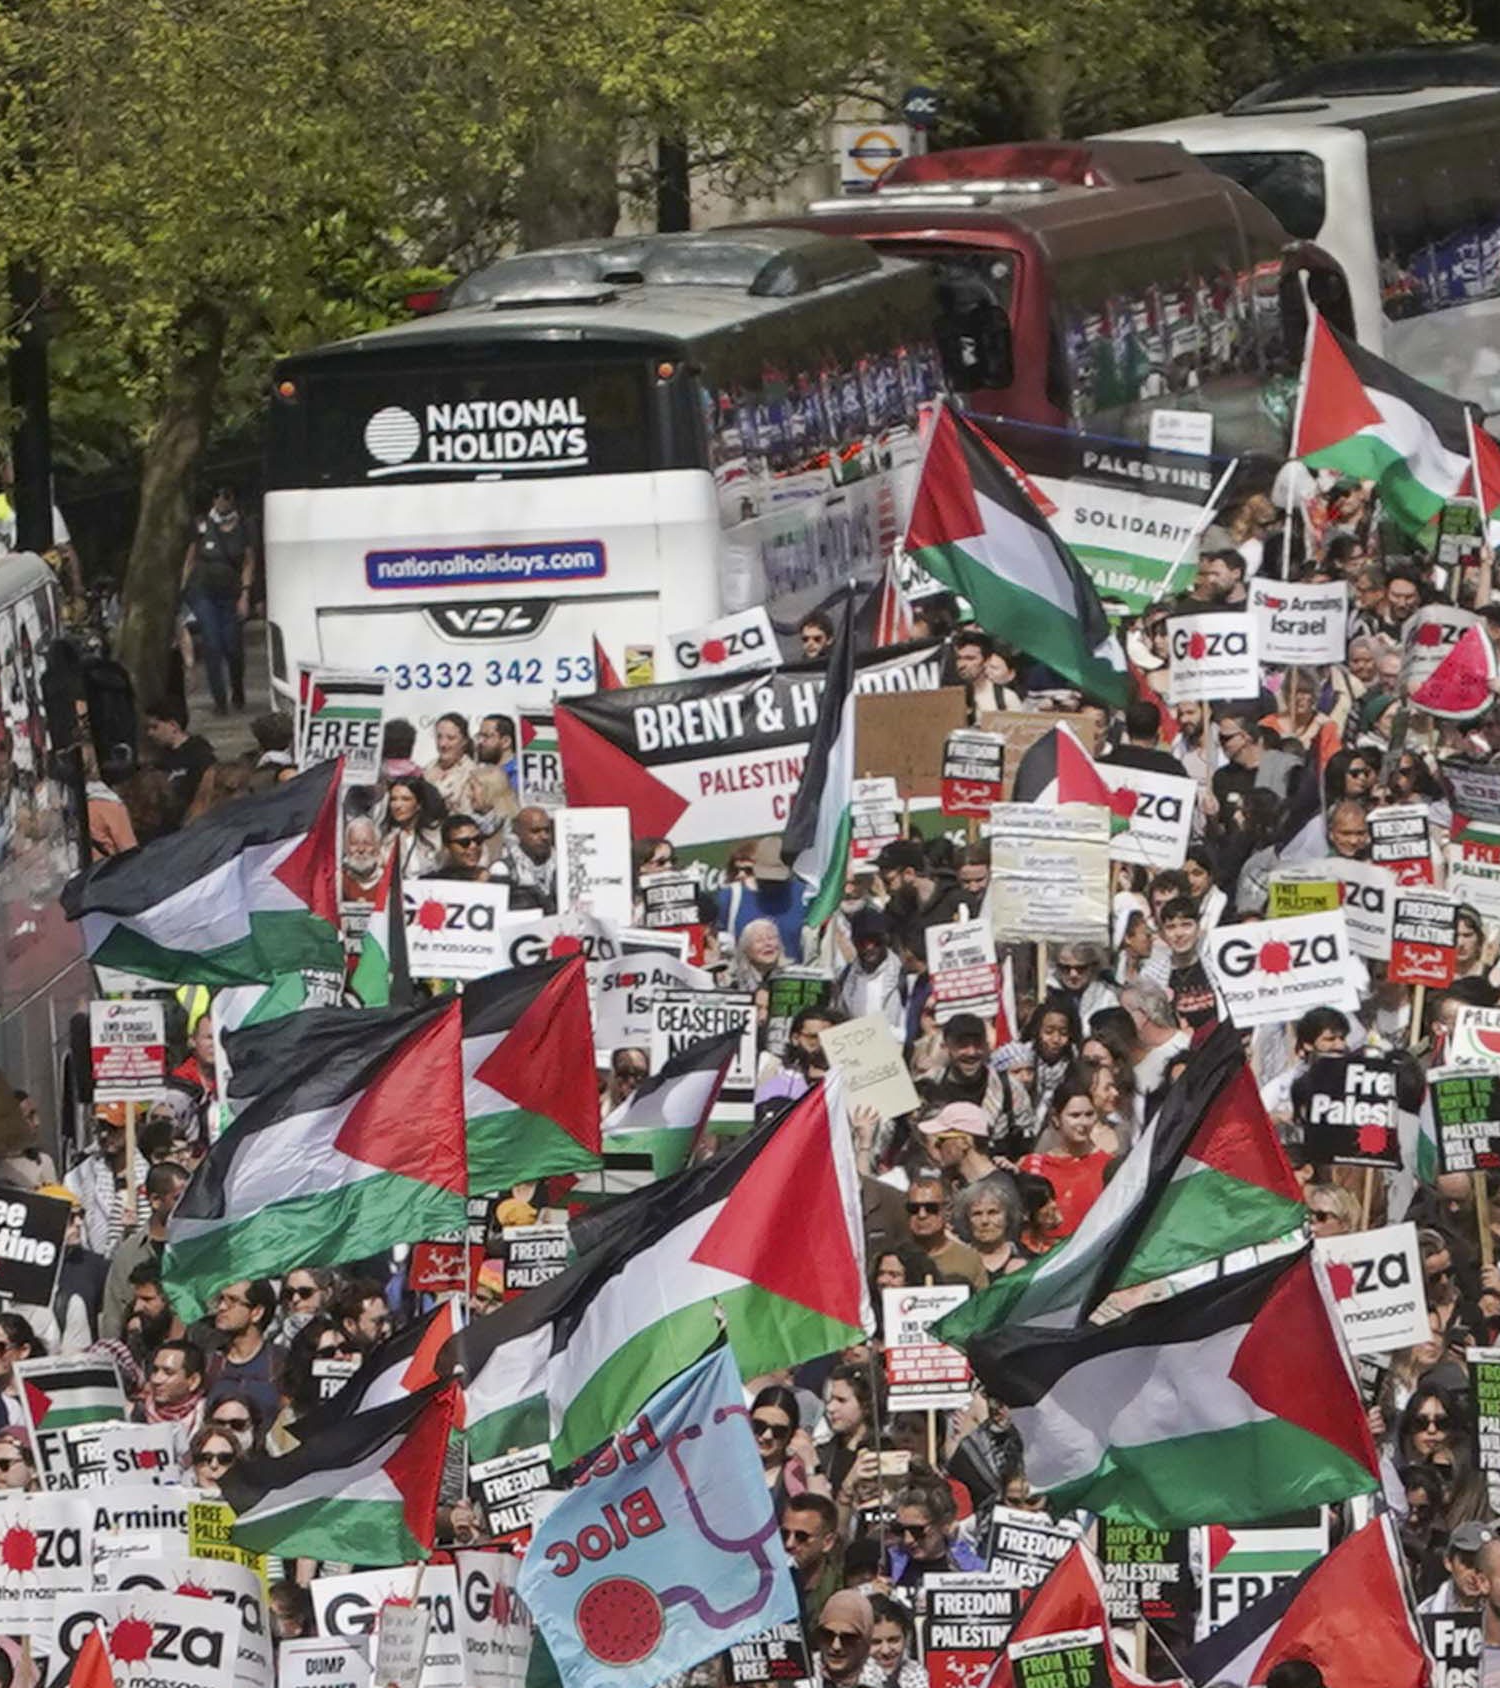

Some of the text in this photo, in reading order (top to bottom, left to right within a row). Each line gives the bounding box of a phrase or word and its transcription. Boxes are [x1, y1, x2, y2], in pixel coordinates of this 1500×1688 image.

[426, 399, 587, 432] NATIONAL
[427, 428, 588, 463] HOLIDAYS
[1083, 451, 1213, 490] PALESTINE
[376, 547, 596, 580] nationalholidays.com
[1270, 612, 1327, 637] Israel
[486, 659, 542, 685] 342
[308, 719, 380, 749] FREE
[635, 686, 786, 754] BRENT &
[1220, 934, 1339, 979] Gza
[95, 1506, 189, 1534] Arming
[933, 1593, 1012, 1618] FREEDOM
[304, 1656, 345, 1676] DUMP
[1021, 1648, 1097, 1675] FROM THE
